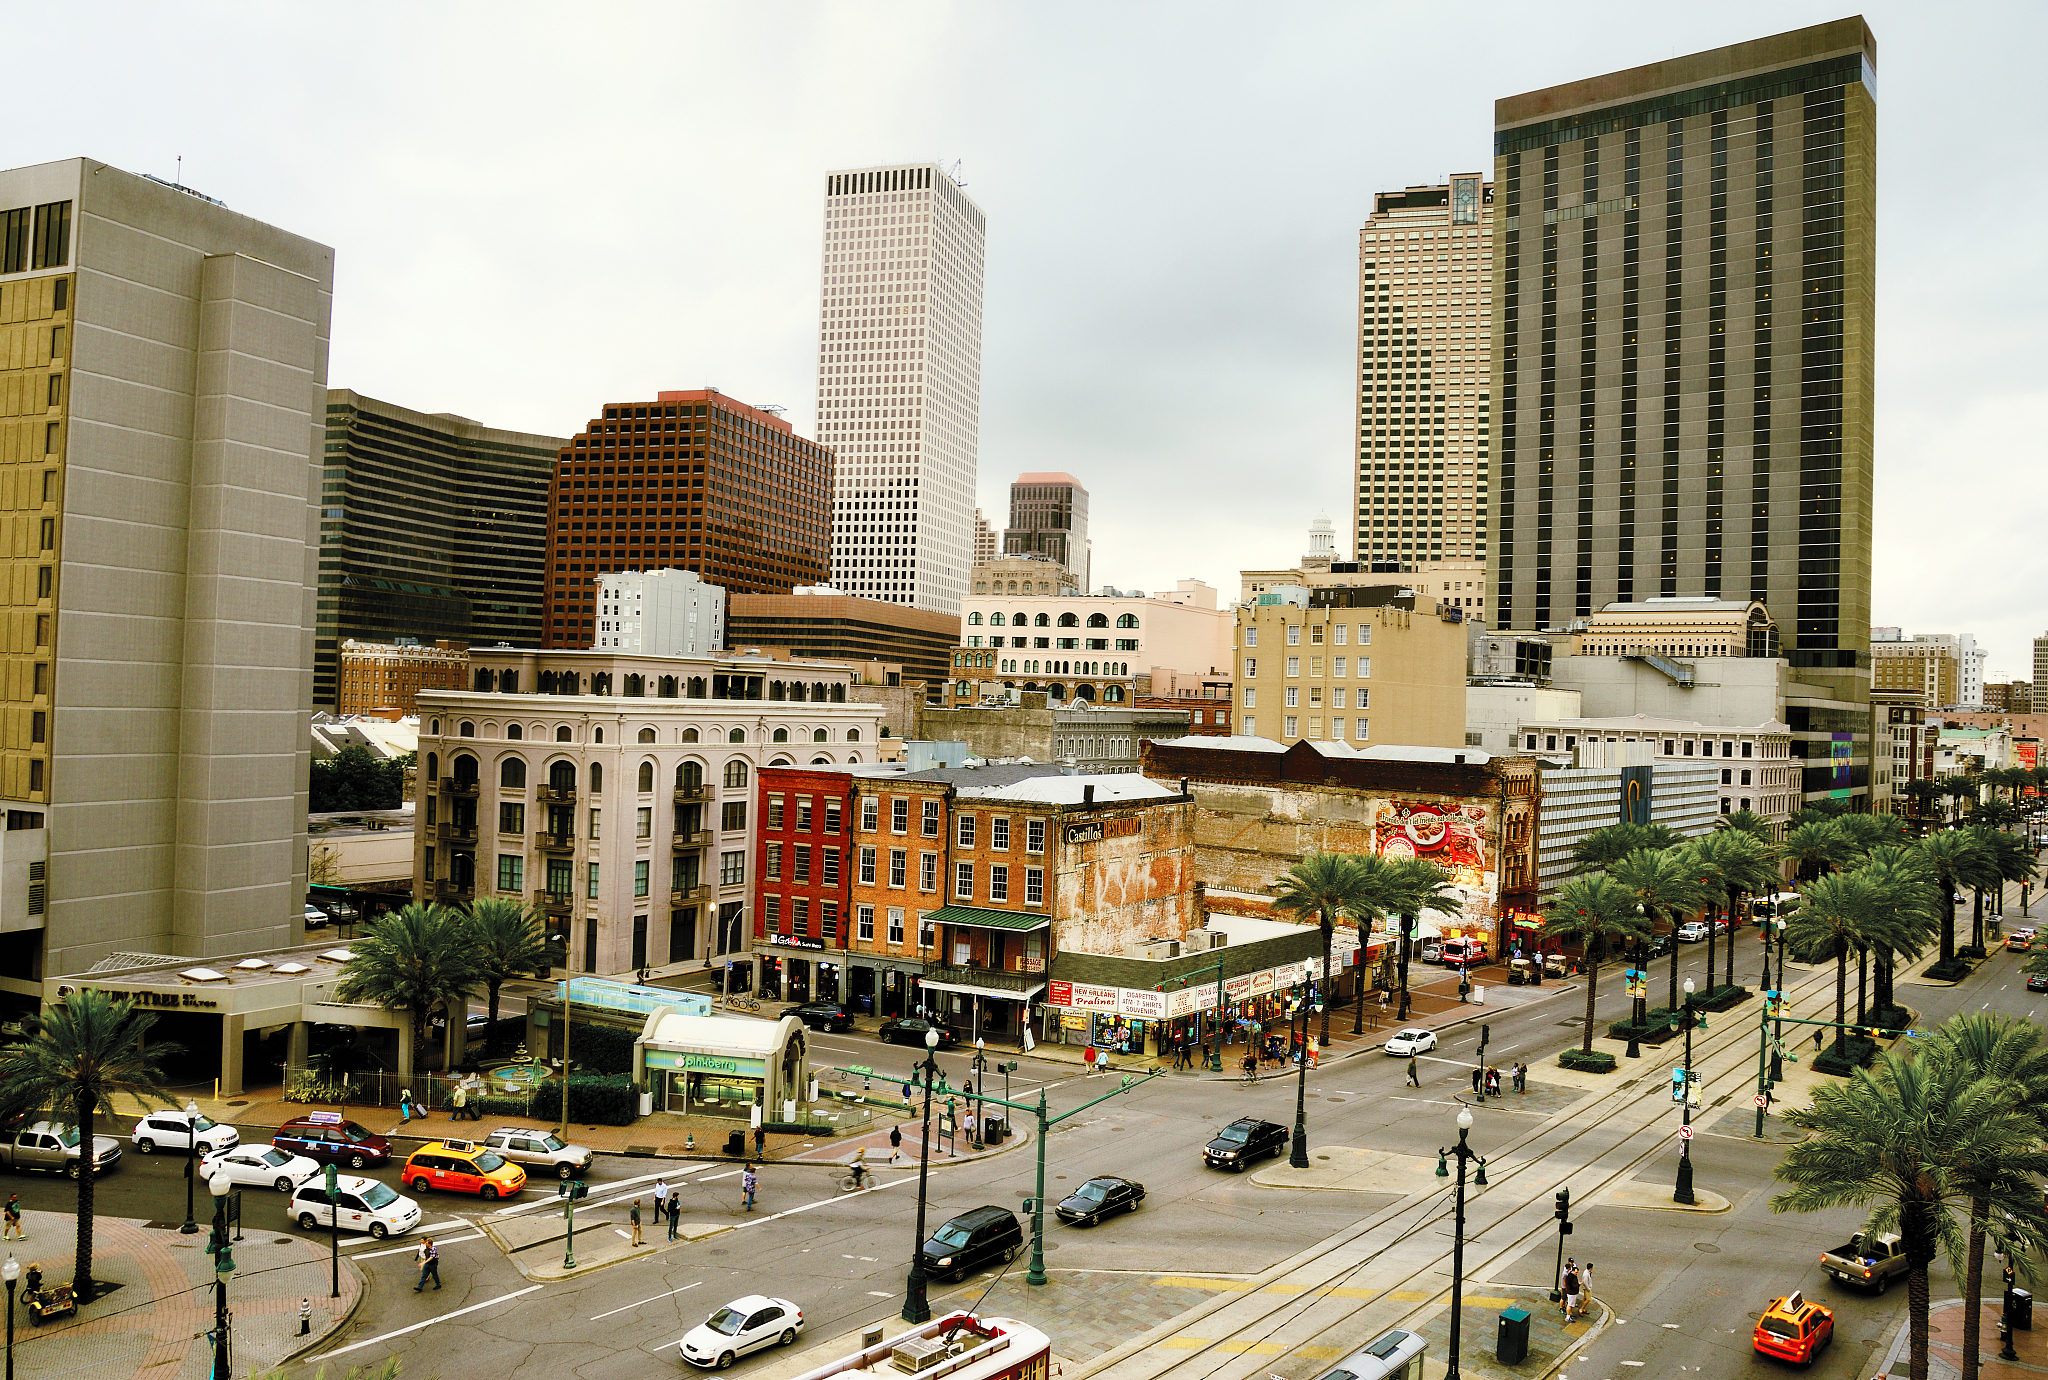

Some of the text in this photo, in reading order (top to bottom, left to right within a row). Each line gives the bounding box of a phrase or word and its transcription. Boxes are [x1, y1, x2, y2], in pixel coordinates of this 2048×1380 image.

[1068, 817, 1140, 842] Castillo's RESTAURANT
[1438, 862, 1474, 878] Fresh Daily
[1088, 990, 1116, 998] ORLEANS
[1126, 992, 1158, 1001] CIGARETTES
[1075, 997, 1115, 1005] Pralines
[1126, 1006, 1157, 1015] SOUVENIRS
[686, 1056, 736, 1072] pinkberry
